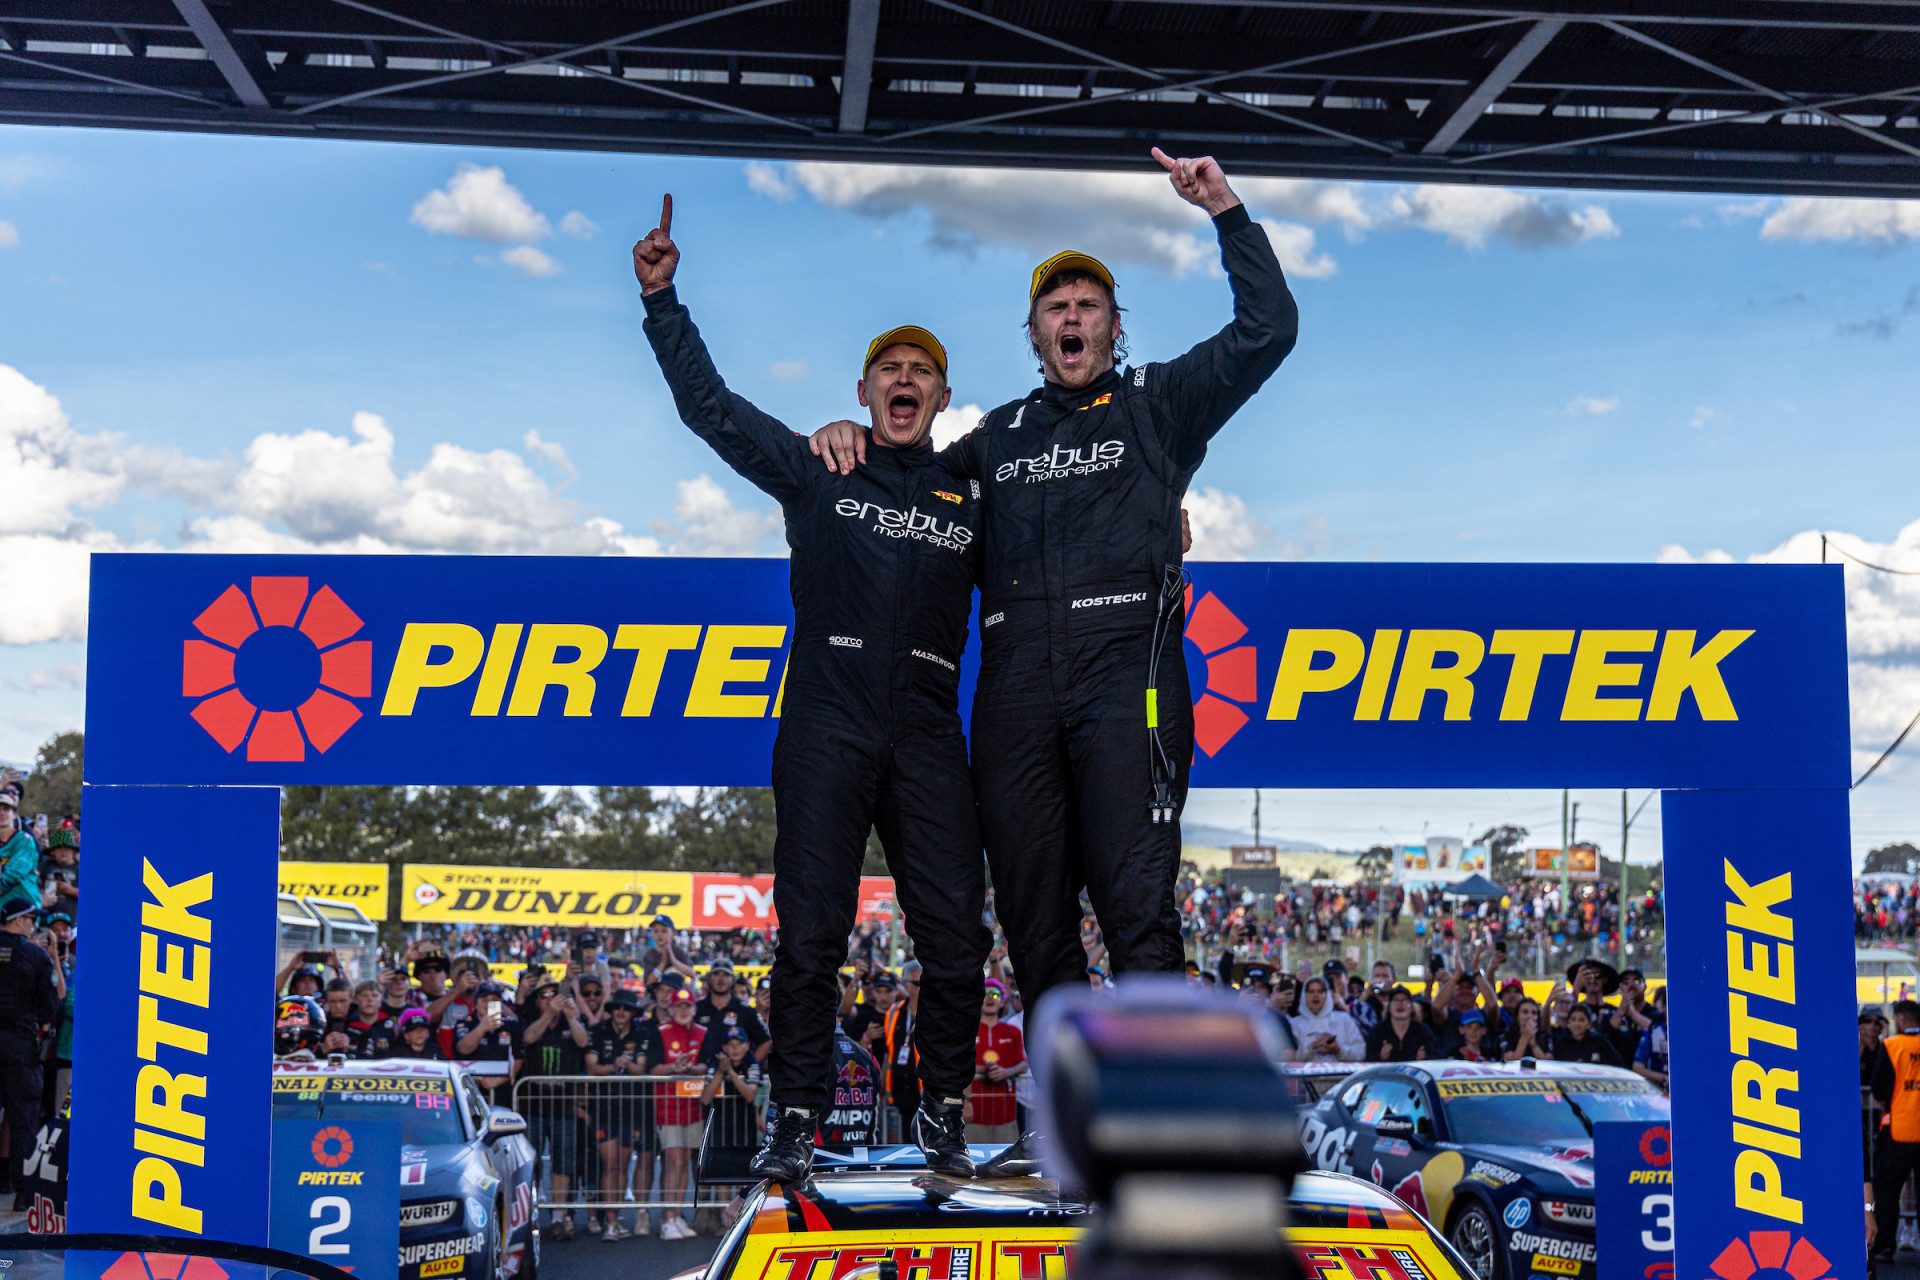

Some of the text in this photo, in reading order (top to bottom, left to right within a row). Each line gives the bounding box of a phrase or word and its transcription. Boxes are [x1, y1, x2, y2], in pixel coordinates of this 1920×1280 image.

[996, 440, 1125, 482] erebus
[1025, 458, 1123, 483] motorsport
[835, 499, 974, 545] erebus
[872, 525, 967, 554] motorsport
[1071, 592, 1147, 609] KOSTECKI
[829, 635, 863, 648] sparco
[380, 622, 788, 718] PIRTE
[911, 649, 955, 671] HAZELWOOD
[1266, 628, 1757, 721] PIRTEK
[443, 873, 542, 886] STICK WITH
[448, 888, 681, 917] DUNLOP
[132, 856, 213, 1235] PIRTEK
[1724, 857, 1803, 1224] PIRTEK
[331, 1079, 441, 1092] STORAGE
[341, 1091, 411, 1105] Feeney
[1443, 1079, 1555, 1095] NATIONAL
[298, 1171, 365, 1186] PIRTEK
[309, 1195, 351, 1255] 2
[1641, 1194, 1674, 1252] 3
[398, 1232, 485, 1267] SUPERCHEAP
[424, 1259, 460, 1274] AUTO
[1536, 1257, 1576, 1272] AUTO
